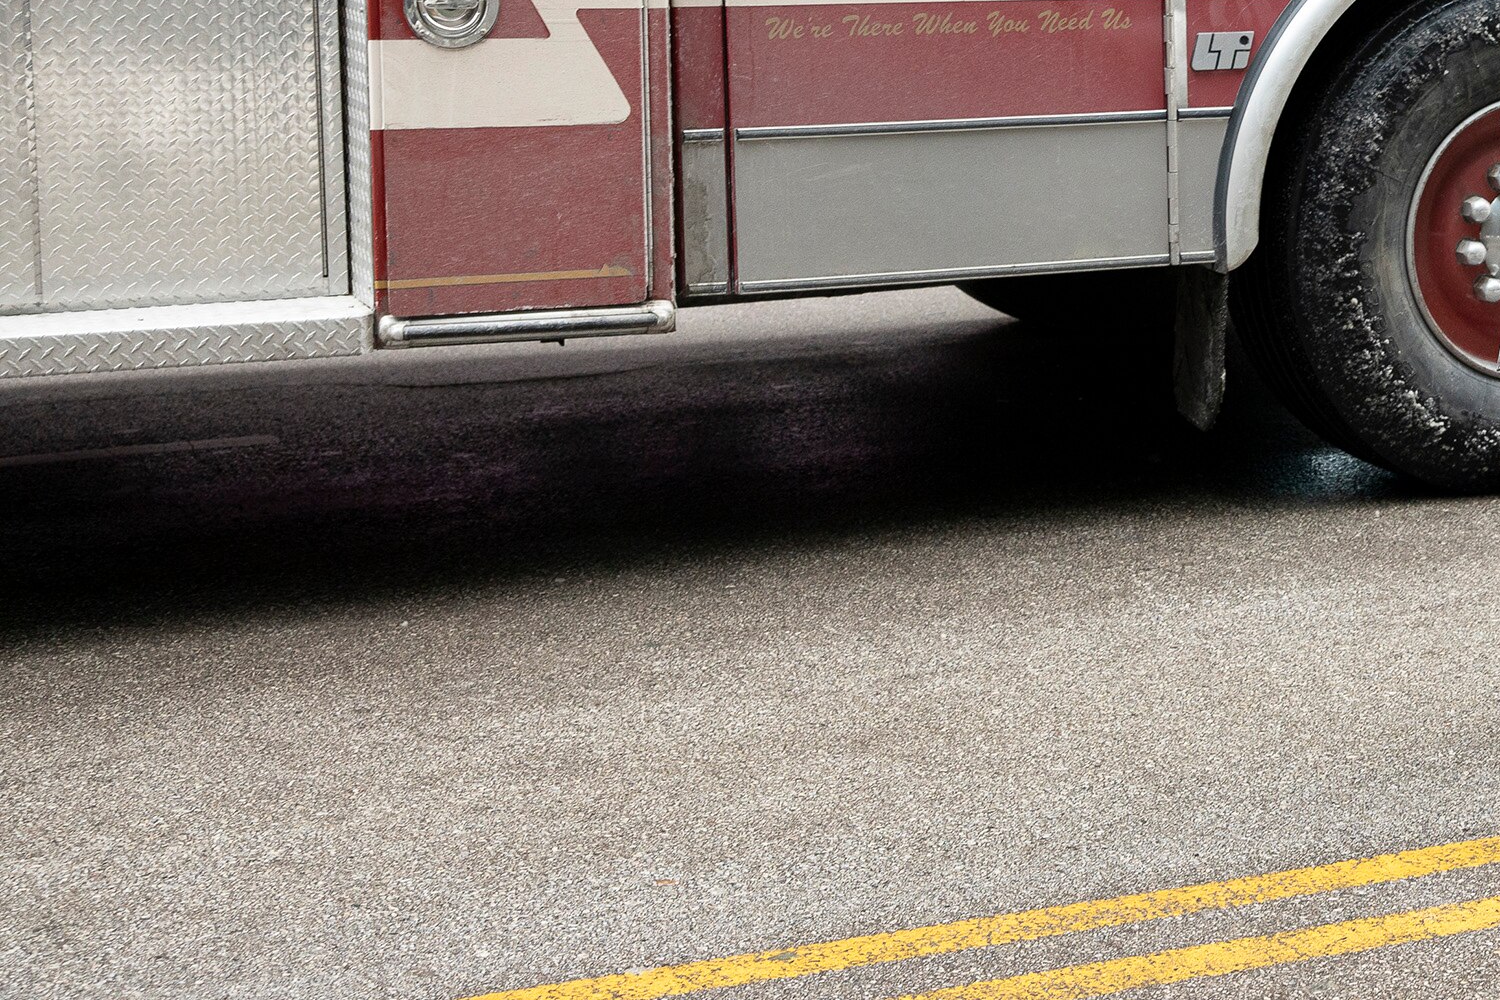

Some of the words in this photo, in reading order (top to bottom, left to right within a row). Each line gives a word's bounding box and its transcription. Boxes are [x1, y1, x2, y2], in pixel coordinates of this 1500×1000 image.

[765, 16, 834, 41] We're
[841, 14, 905, 37] There
[911, 11, 979, 36] When
[986, 10, 1030, 38] You
[1037, 9, 1095, 34] Need
[1101, 8, 1134, 31] Us
